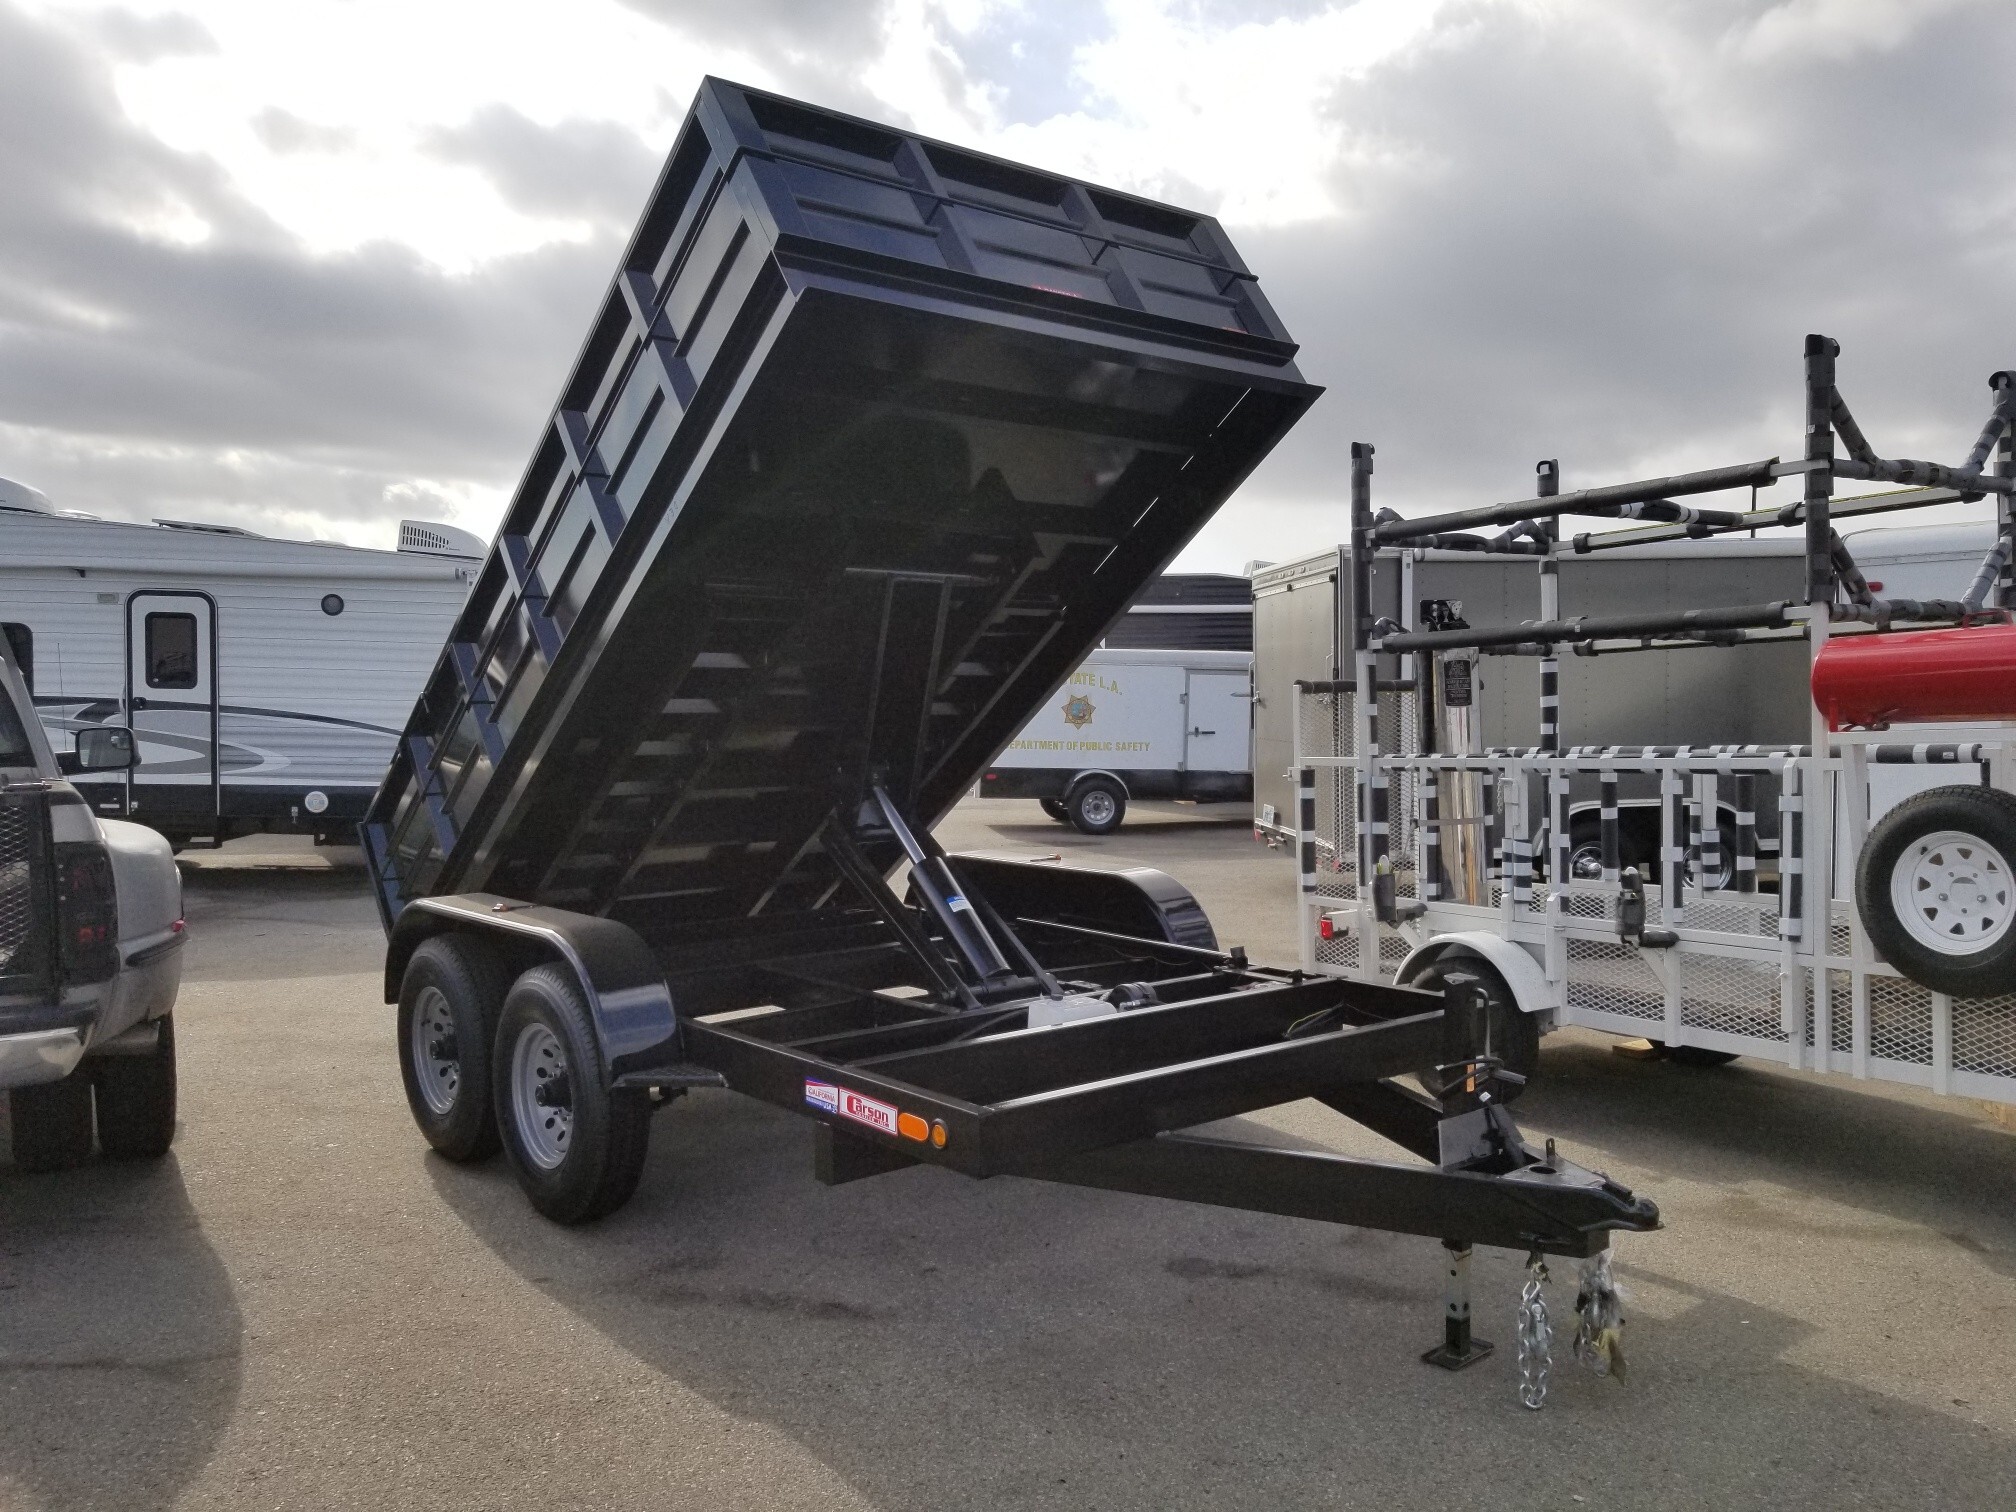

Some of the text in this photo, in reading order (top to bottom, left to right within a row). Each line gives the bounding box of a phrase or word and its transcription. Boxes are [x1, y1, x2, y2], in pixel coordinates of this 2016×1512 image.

[1069, 672, 1122, 695] TATE L.A.
[1008, 740, 1150, 752] EPARTMENT OF PUBLIC SAFETY
[847, 1095, 889, 1122] Carson
